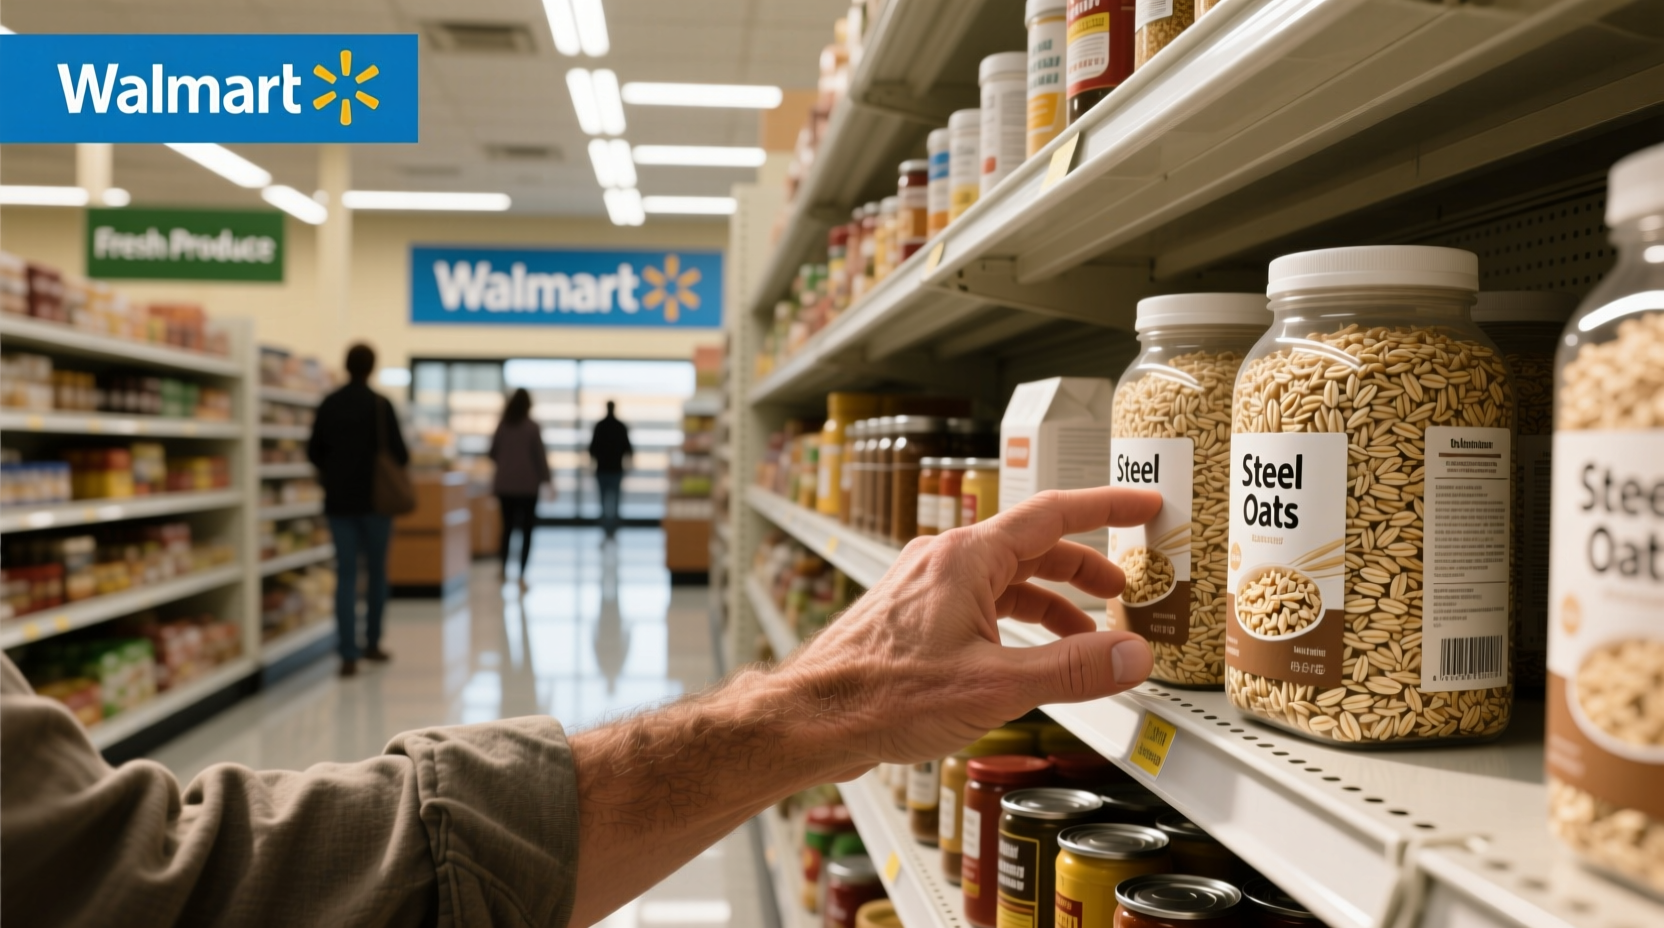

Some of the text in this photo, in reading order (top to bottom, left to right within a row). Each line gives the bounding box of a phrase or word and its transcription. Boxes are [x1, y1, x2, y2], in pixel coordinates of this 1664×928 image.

[93, 226, 277, 264] Fresh Produce
[433, 259, 641, 315] Walmart
[1117, 453, 1160, 484] Steel
[1242, 453, 1303, 490] Steel
[1243, 493, 1299, 529] Oats
